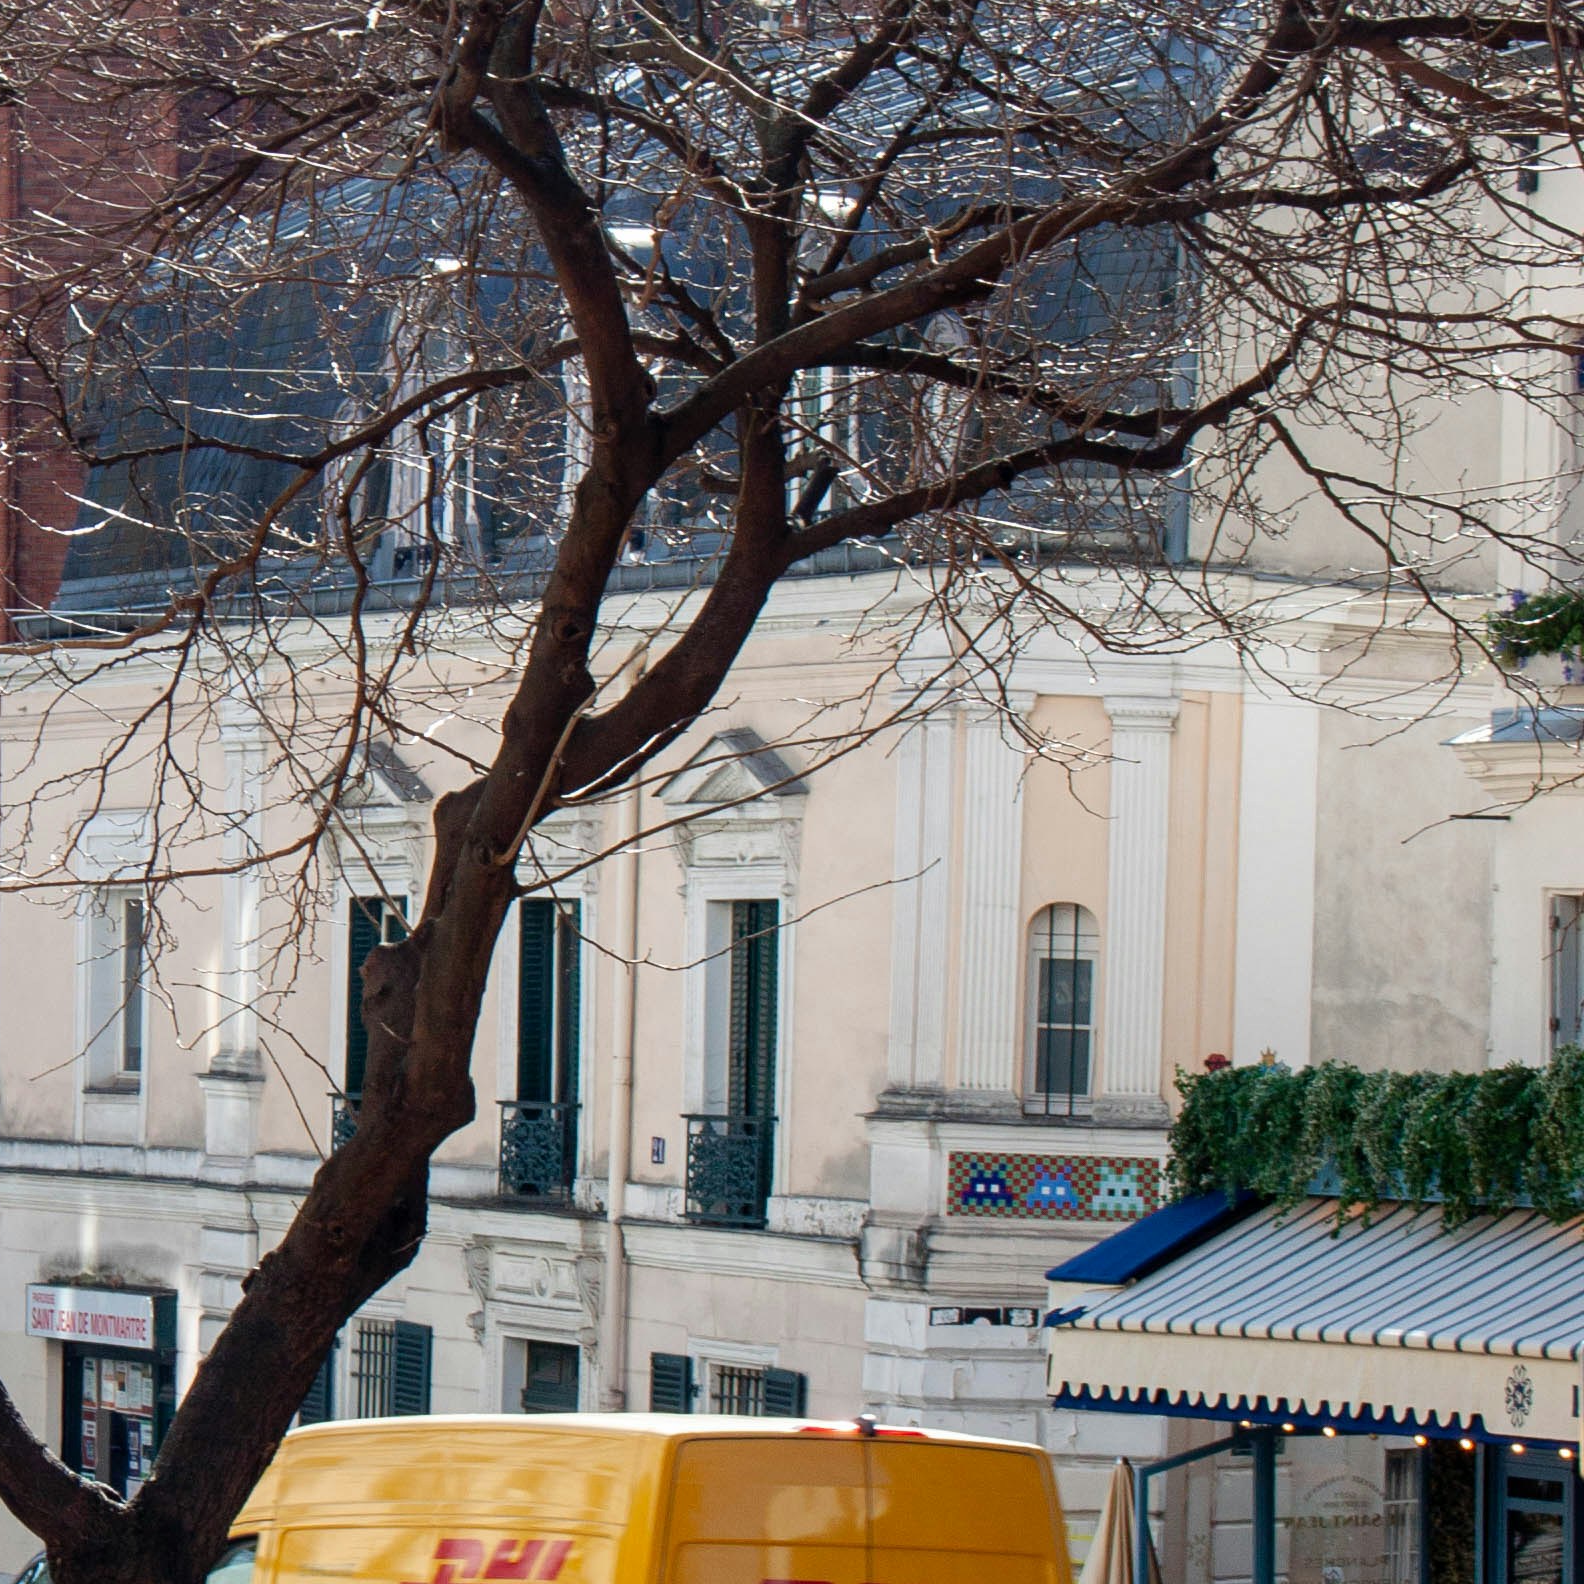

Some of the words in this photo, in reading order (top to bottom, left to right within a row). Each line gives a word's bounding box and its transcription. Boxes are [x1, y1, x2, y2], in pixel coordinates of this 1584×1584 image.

[31, 1306, 54, 1331] SAINT
[57, 1309, 76, 1334] JEAN
[78, 1311, 89, 1335] DE
[90, 1313, 147, 1342] MONTMARTRE
